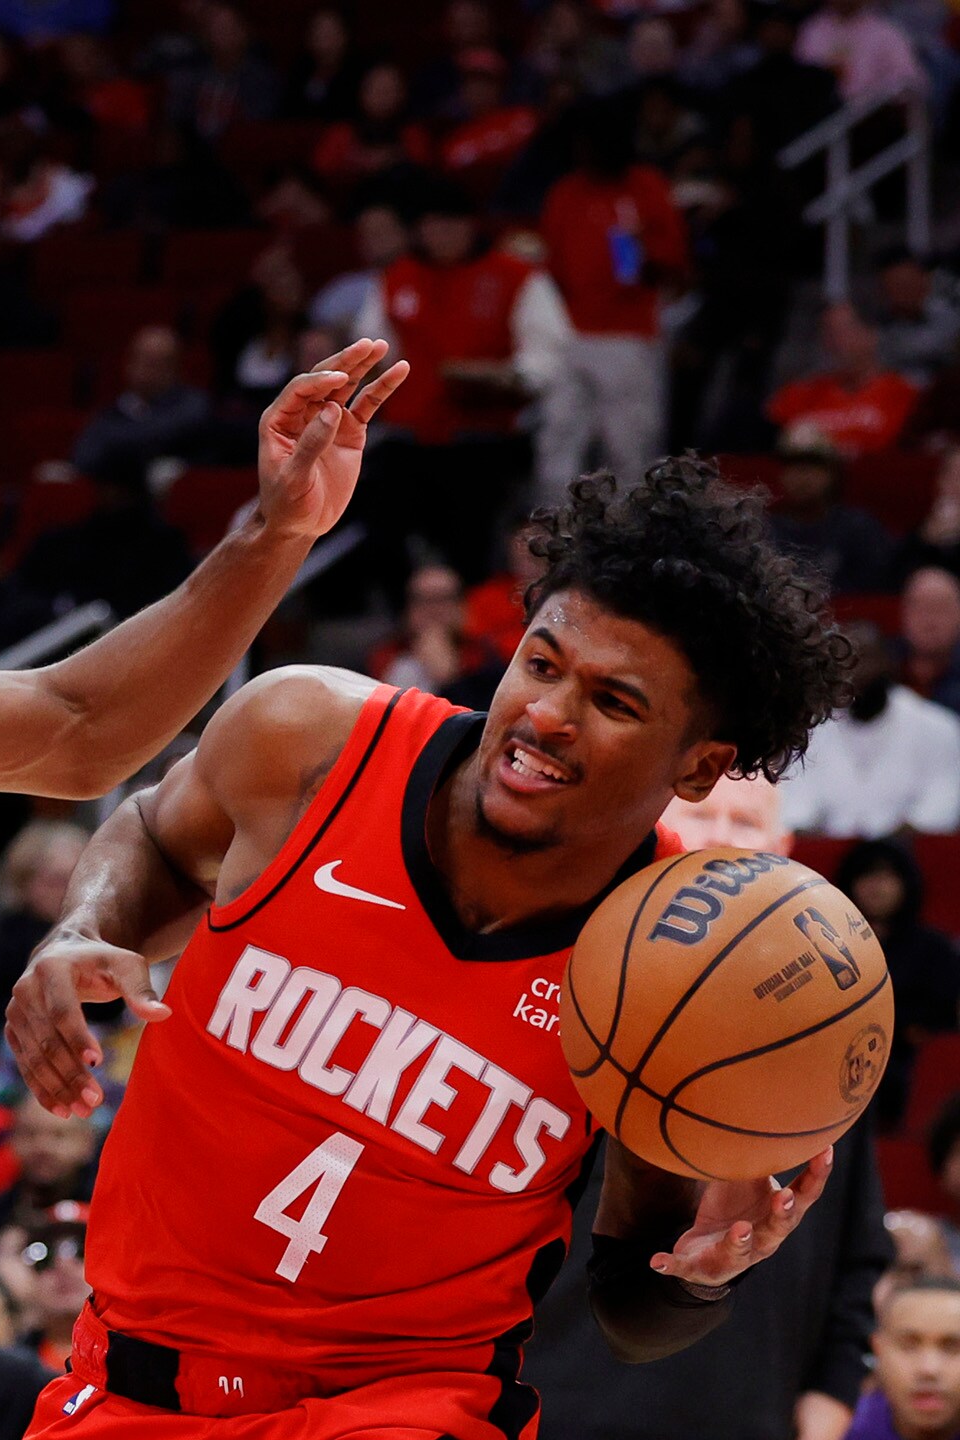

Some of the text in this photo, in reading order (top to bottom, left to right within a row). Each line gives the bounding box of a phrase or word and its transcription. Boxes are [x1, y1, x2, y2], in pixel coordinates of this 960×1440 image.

[206, 943, 572, 1193] ROCKETS
[512, 993, 561, 1037] kar
[253, 1131, 365, 1283] 4
